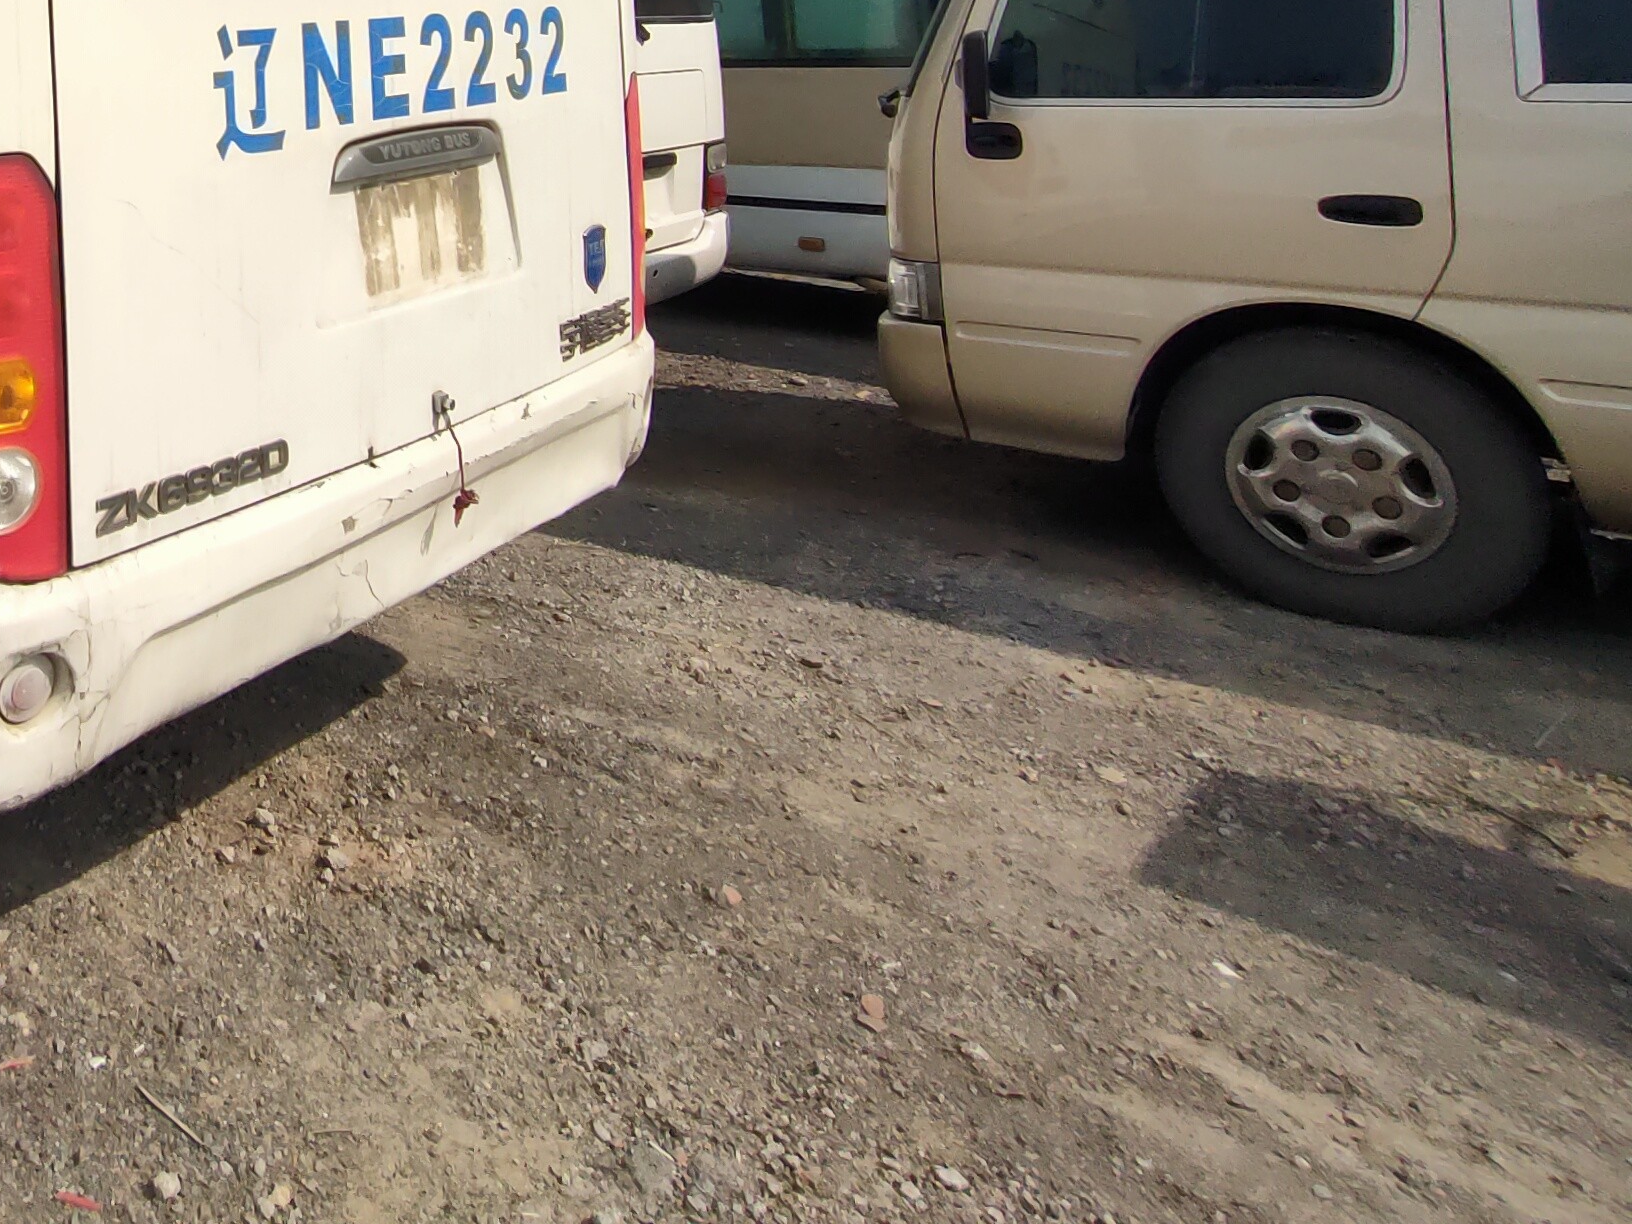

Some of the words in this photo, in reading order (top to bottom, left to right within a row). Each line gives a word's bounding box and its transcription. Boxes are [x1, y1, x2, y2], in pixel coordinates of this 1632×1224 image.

[212, 5, 568, 162] 辽NE2232
[378, 136, 442, 161] YUTONG
[443, 131, 471, 151] BUS
